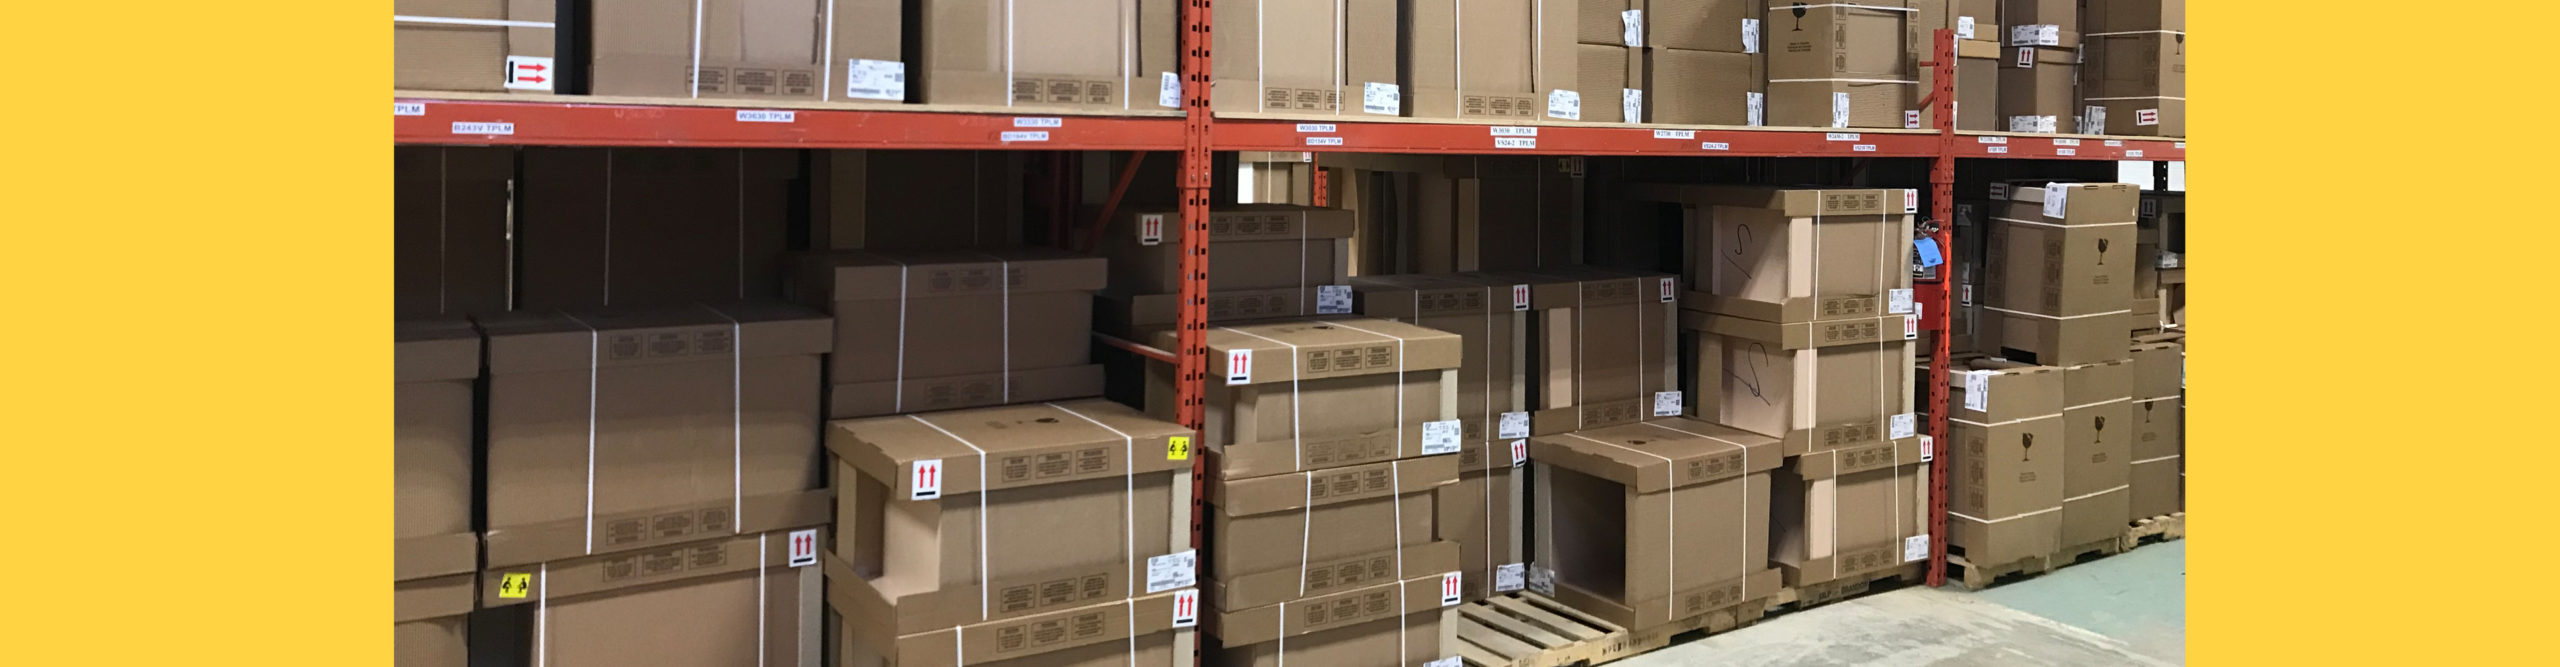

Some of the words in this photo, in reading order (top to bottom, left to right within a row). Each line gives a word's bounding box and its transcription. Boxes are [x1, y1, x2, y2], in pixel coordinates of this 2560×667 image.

[768, 112, 792, 121] TPLM
[1041, 118, 1060, 126] TPLM
[486, 124, 512, 133] TPLM
